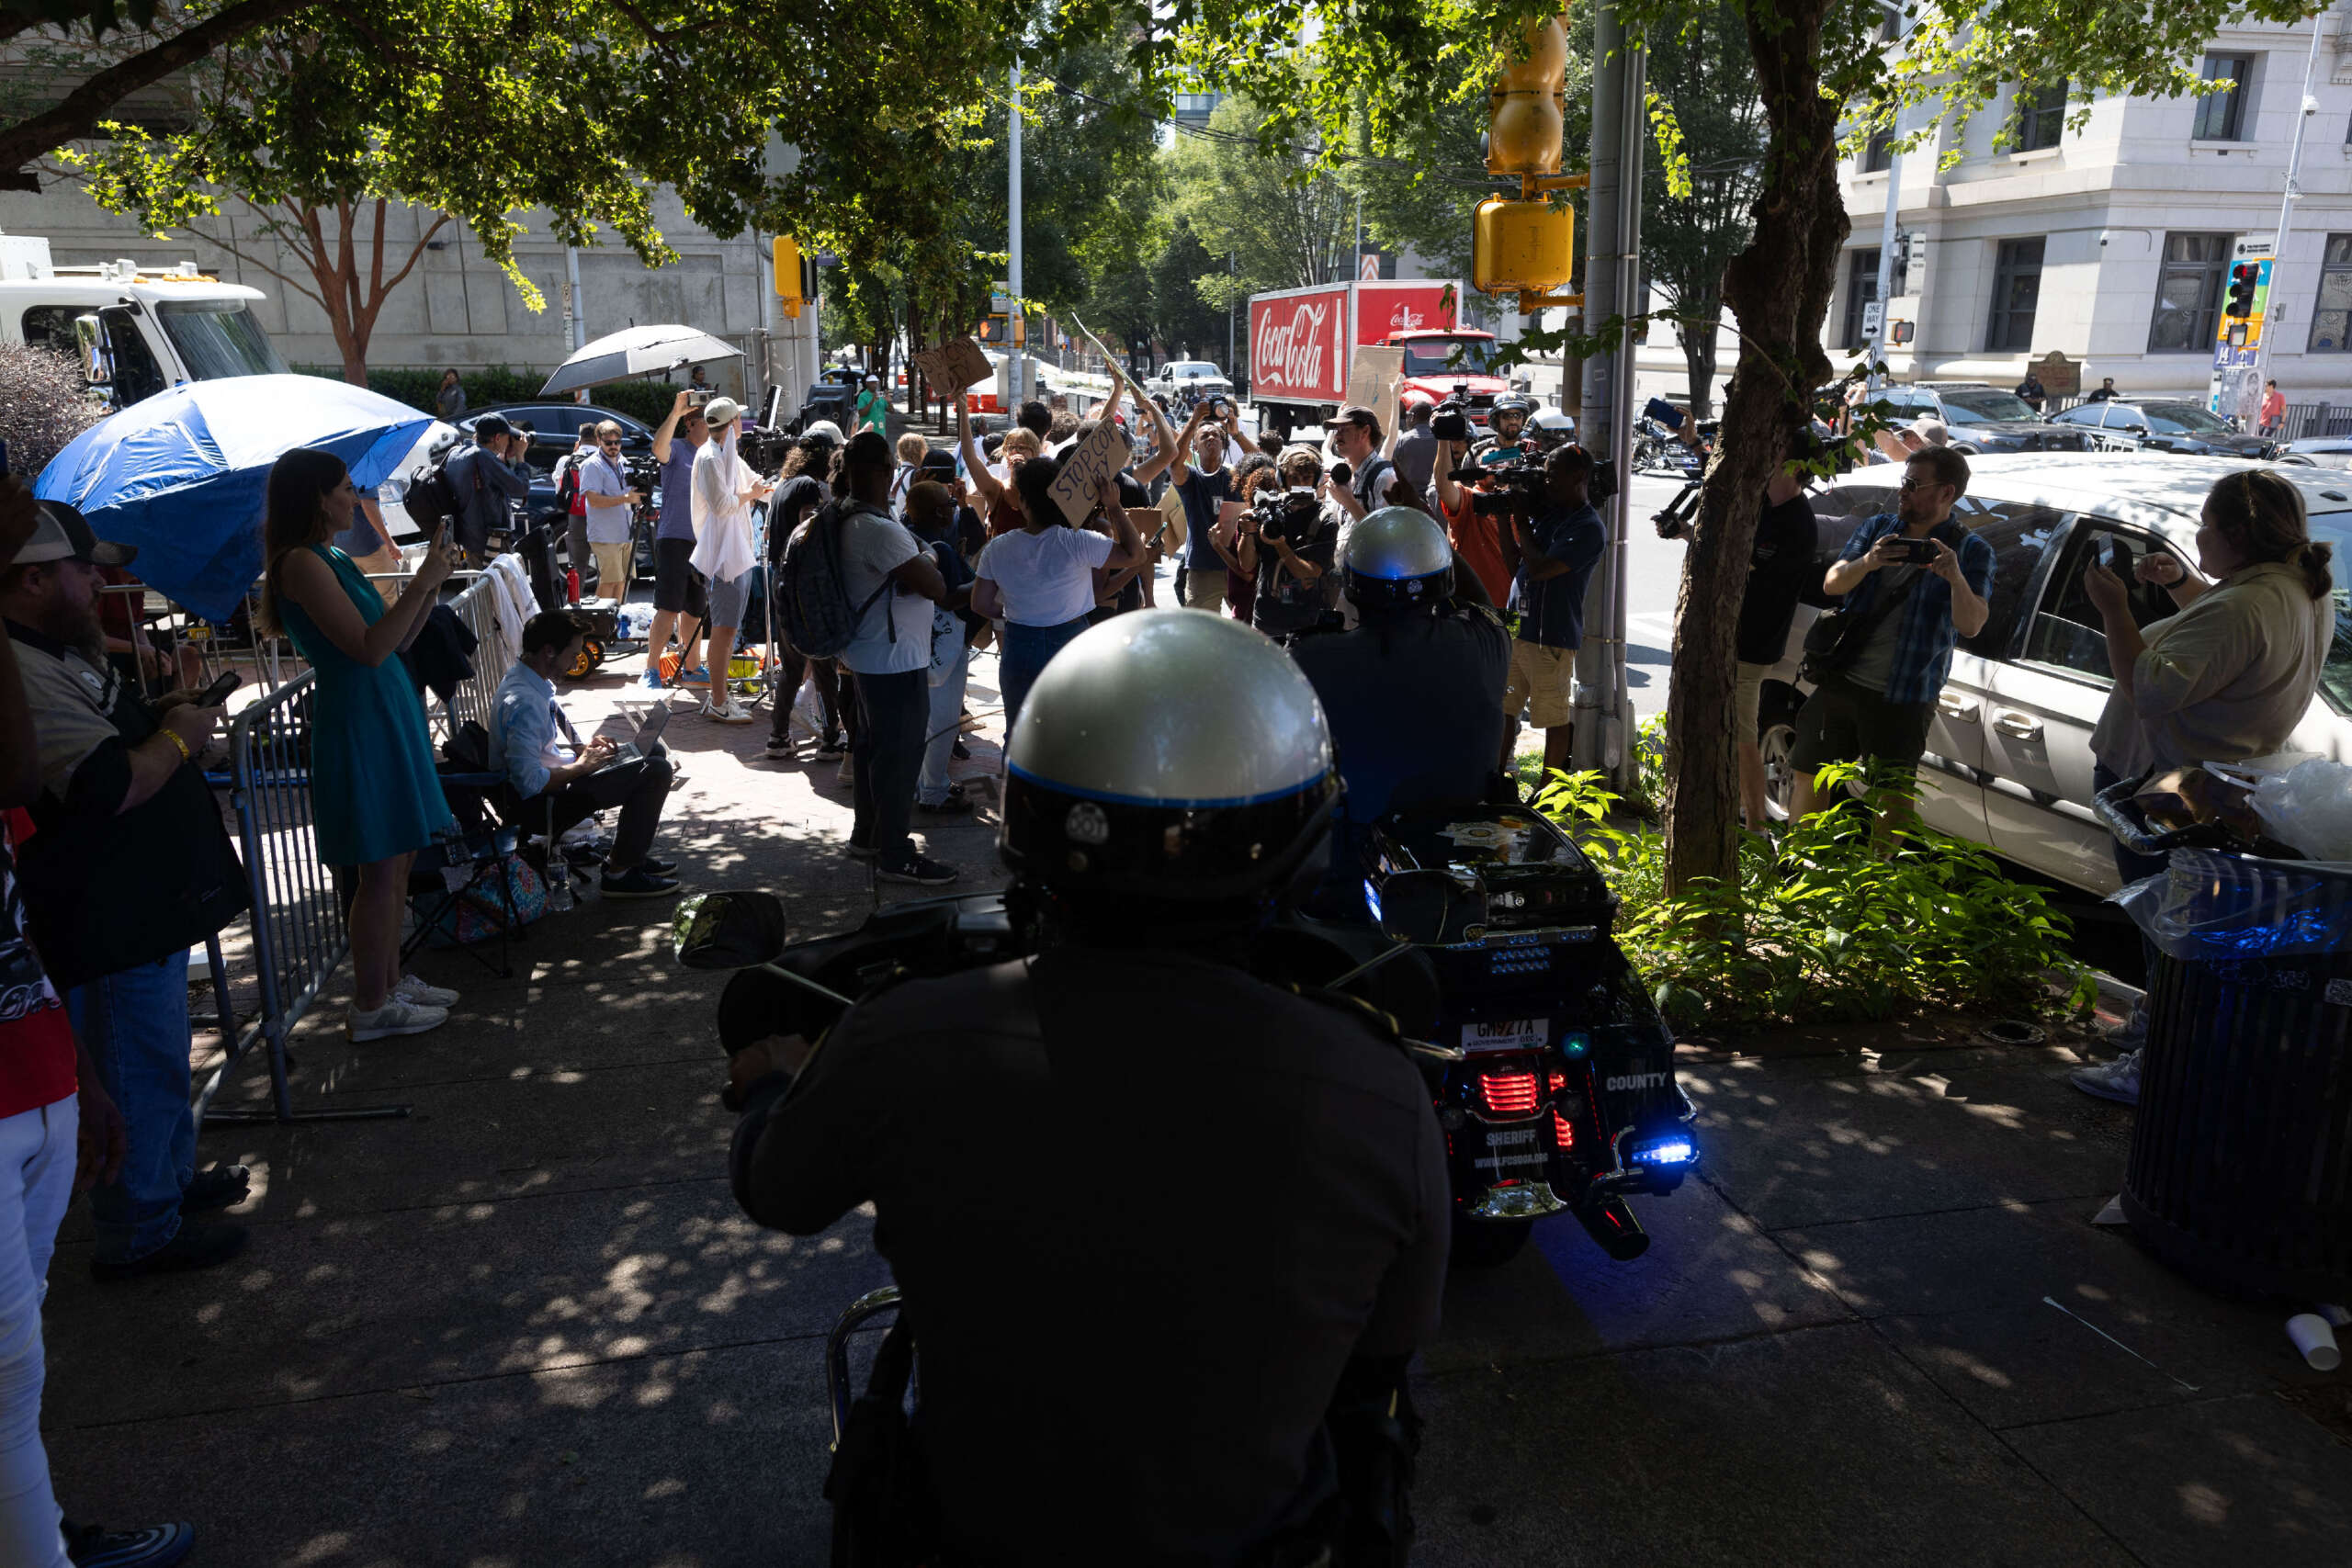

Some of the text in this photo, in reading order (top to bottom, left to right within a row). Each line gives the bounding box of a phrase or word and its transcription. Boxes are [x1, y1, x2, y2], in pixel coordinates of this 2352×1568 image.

[1867, 304, 1882, 313] ONE
[1866, 314, 1880, 323] WAY
[1256, 302, 1327, 388] Coca-Cola
[1056, 419, 1115, 501] STOP COP
[1606, 1072, 1668, 1091] COUNTY
[1486, 1129, 1537, 1146] SHERIFF
